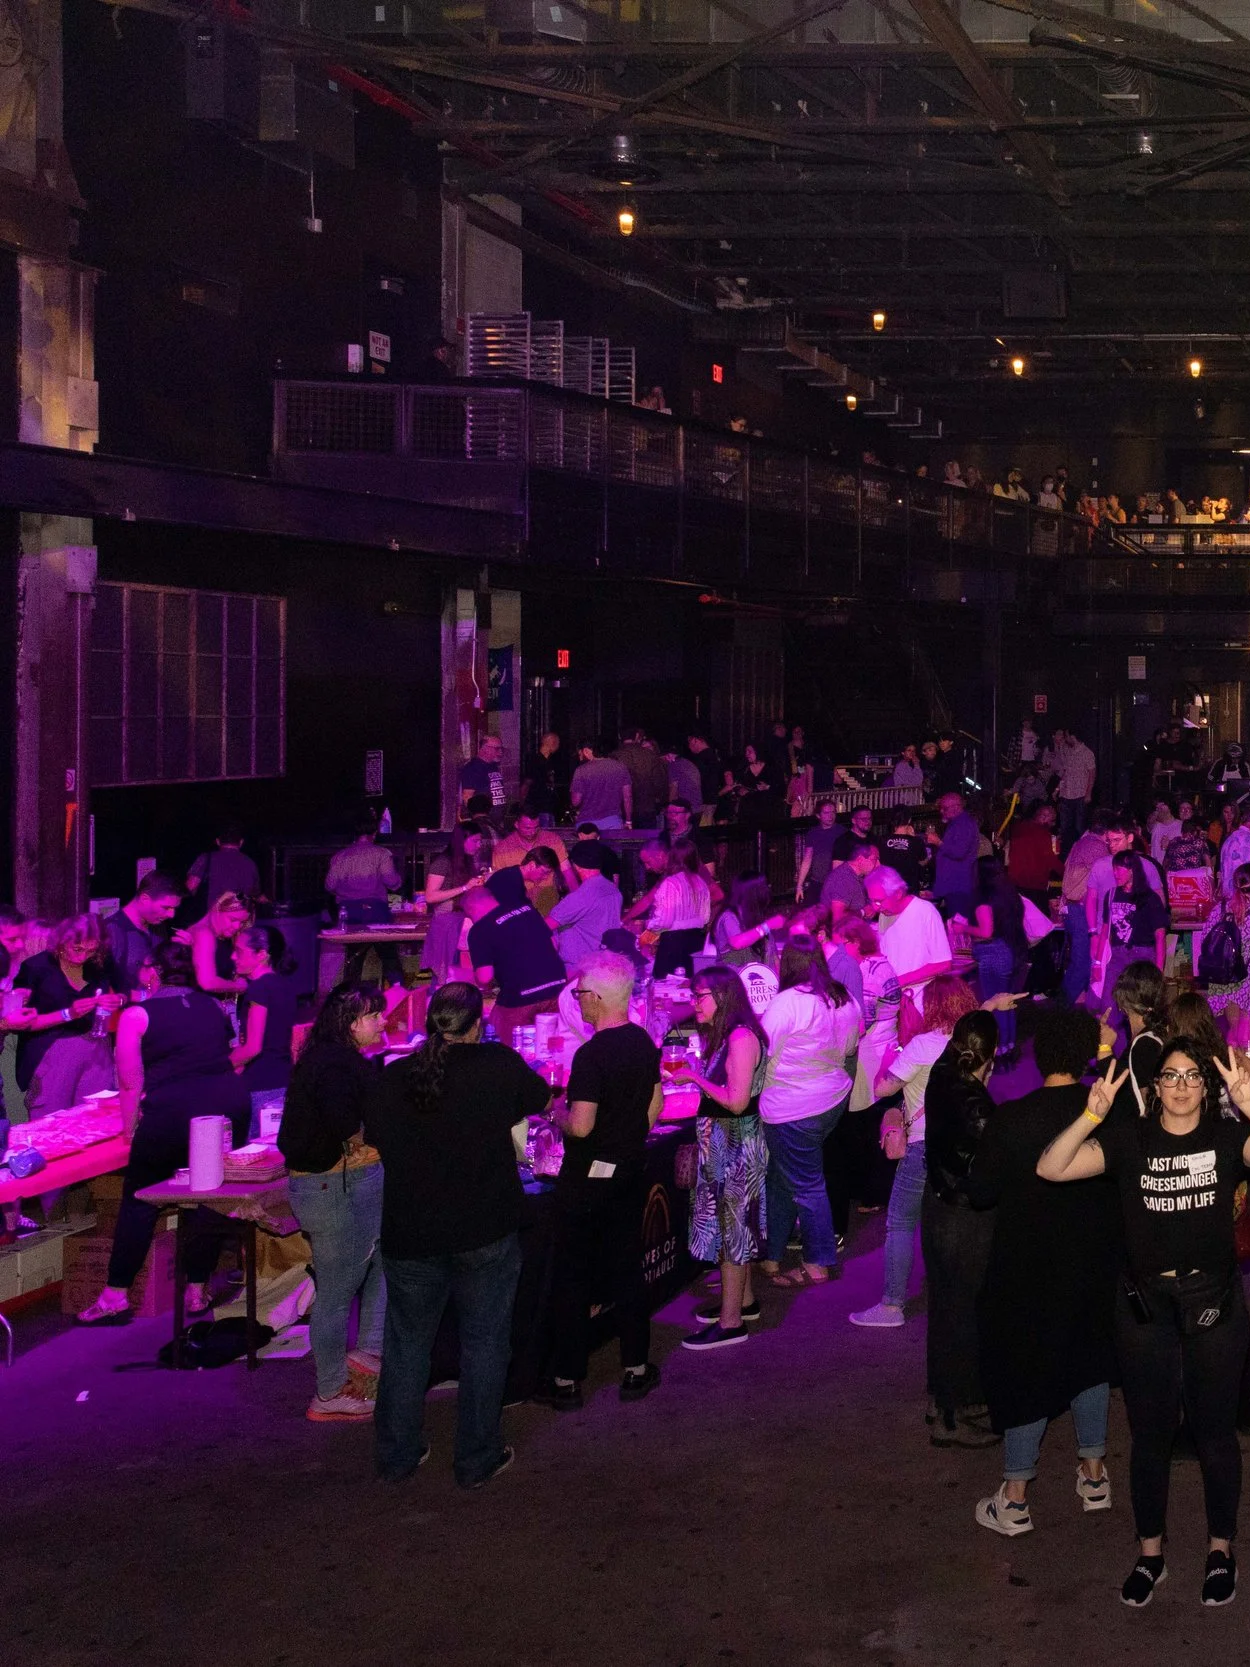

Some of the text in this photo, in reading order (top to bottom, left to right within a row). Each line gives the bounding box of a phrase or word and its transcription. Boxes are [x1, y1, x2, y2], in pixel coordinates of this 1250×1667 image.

[713, 363, 723, 384] EXIT
[557, 649, 569, 668] EXIT
[750, 985, 777, 995] PRESS
[751, 994, 773, 1003] ROVE
[1147, 1157, 1171, 1171] LAST
[1172, 1155, 1188, 1170] NIG
[1140, 1170, 1218, 1192] CHEESEMONGER
[1143, 1191, 1216, 1212] SAVED MY LIFE
